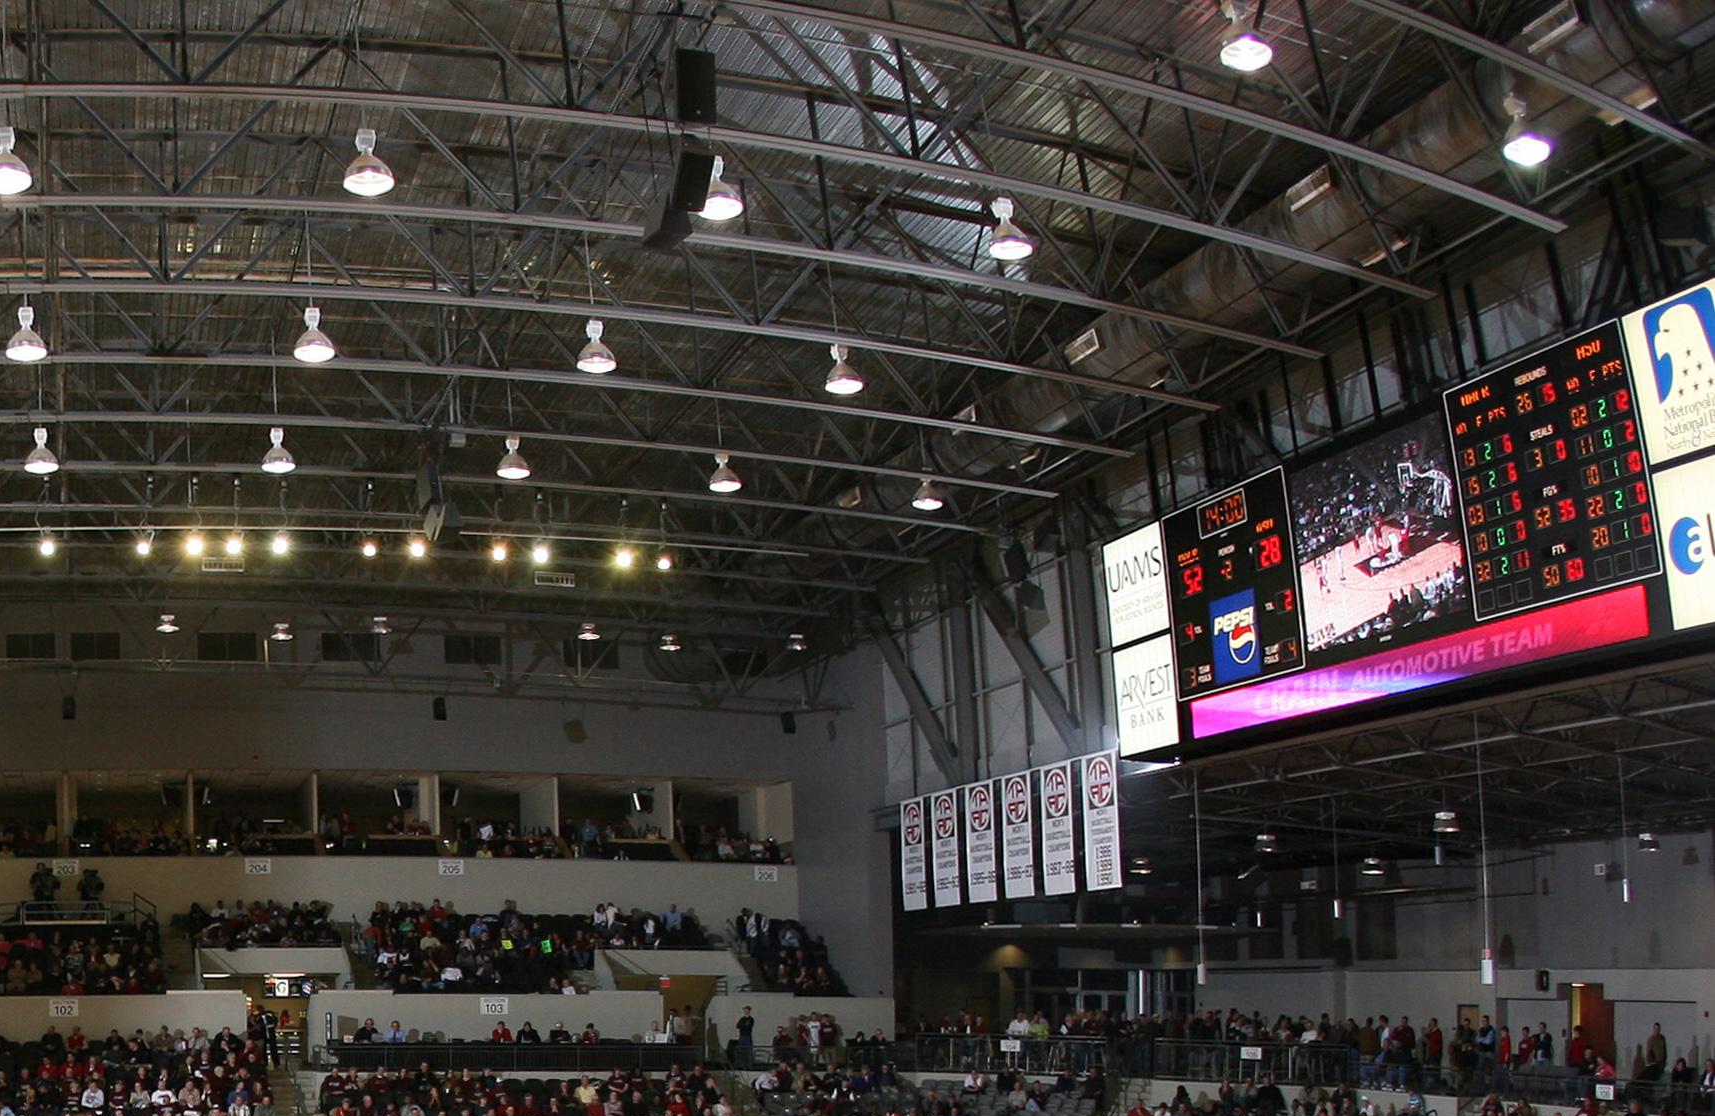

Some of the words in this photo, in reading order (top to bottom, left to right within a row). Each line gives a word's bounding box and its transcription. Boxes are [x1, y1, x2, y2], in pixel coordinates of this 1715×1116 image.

[1517, 393, 1533, 414] 26
[1571, 404, 1588, 427] 02
[1598, 399, 1606, 418] 2
[1663, 392, 1715, 421] Metropoli
[1464, 448, 1476, 467] 13
[1484, 443, 1491, 460] 2
[1502, 433, 1513, 453] 6
[1581, 436, 1594, 455] 11
[1603, 429, 1613, 448] 0
[1624, 420, 1635, 442] 2
[1535, 449, 1544, 468] 3
[1555, 439, 1566, 460] 0
[1467, 476, 1480, 496] 15
[1488, 471, 1496, 488] 2
[1507, 462, 1518, 483] 6
[1587, 465, 1599, 486] 10
[1615, 460, 1620, 478] 1
[1206, 491, 1244, 530] 14:00
[1468, 505, 1484, 525] 03
[1497, 501, 1501, 515] 1
[1511, 491, 1522, 512] 6
[1588, 496, 1604, 518] 22
[1615, 490, 1623, 510] 2
[1636, 482, 1647, 504] 0
[1536, 506, 1551, 528] 52
[1592, 526, 1609, 548] 20
[1624, 522, 1629, 539] 1
[1641, 513, 1652, 535] 0
[1476, 532, 1487, 551] 10
[1497, 528, 1506, 546] 0
[1516, 519, 1526, 540] 0
[1258, 535, 1282, 567] 28
[1107, 546, 1162, 593] UAMS
[1182, 565, 1205, 596] 52
[1477, 560, 1491, 581] 32
[1502, 557, 1508, 575] 2
[1544, 565, 1560, 587] 50
[1285, 589, 1294, 611] 2
[1185, 623, 1194, 641] 4
[1214, 606, 1254, 635] PEPSI
[1490, 623, 1553, 657] TEAM
[1350, 638, 1485, 688] AUTOMOTIVE
[1120, 664, 1170, 709] ARVEST
[1130, 706, 1165, 728] BANK
[56, 865, 75, 875] 203
[248, 864, 267, 873] 204
[442, 865, 460, 875] 205
[758, 872, 774, 881] 206
[54, 1006, 73, 1015] 102
[485, 1004, 503, 1013] 103
